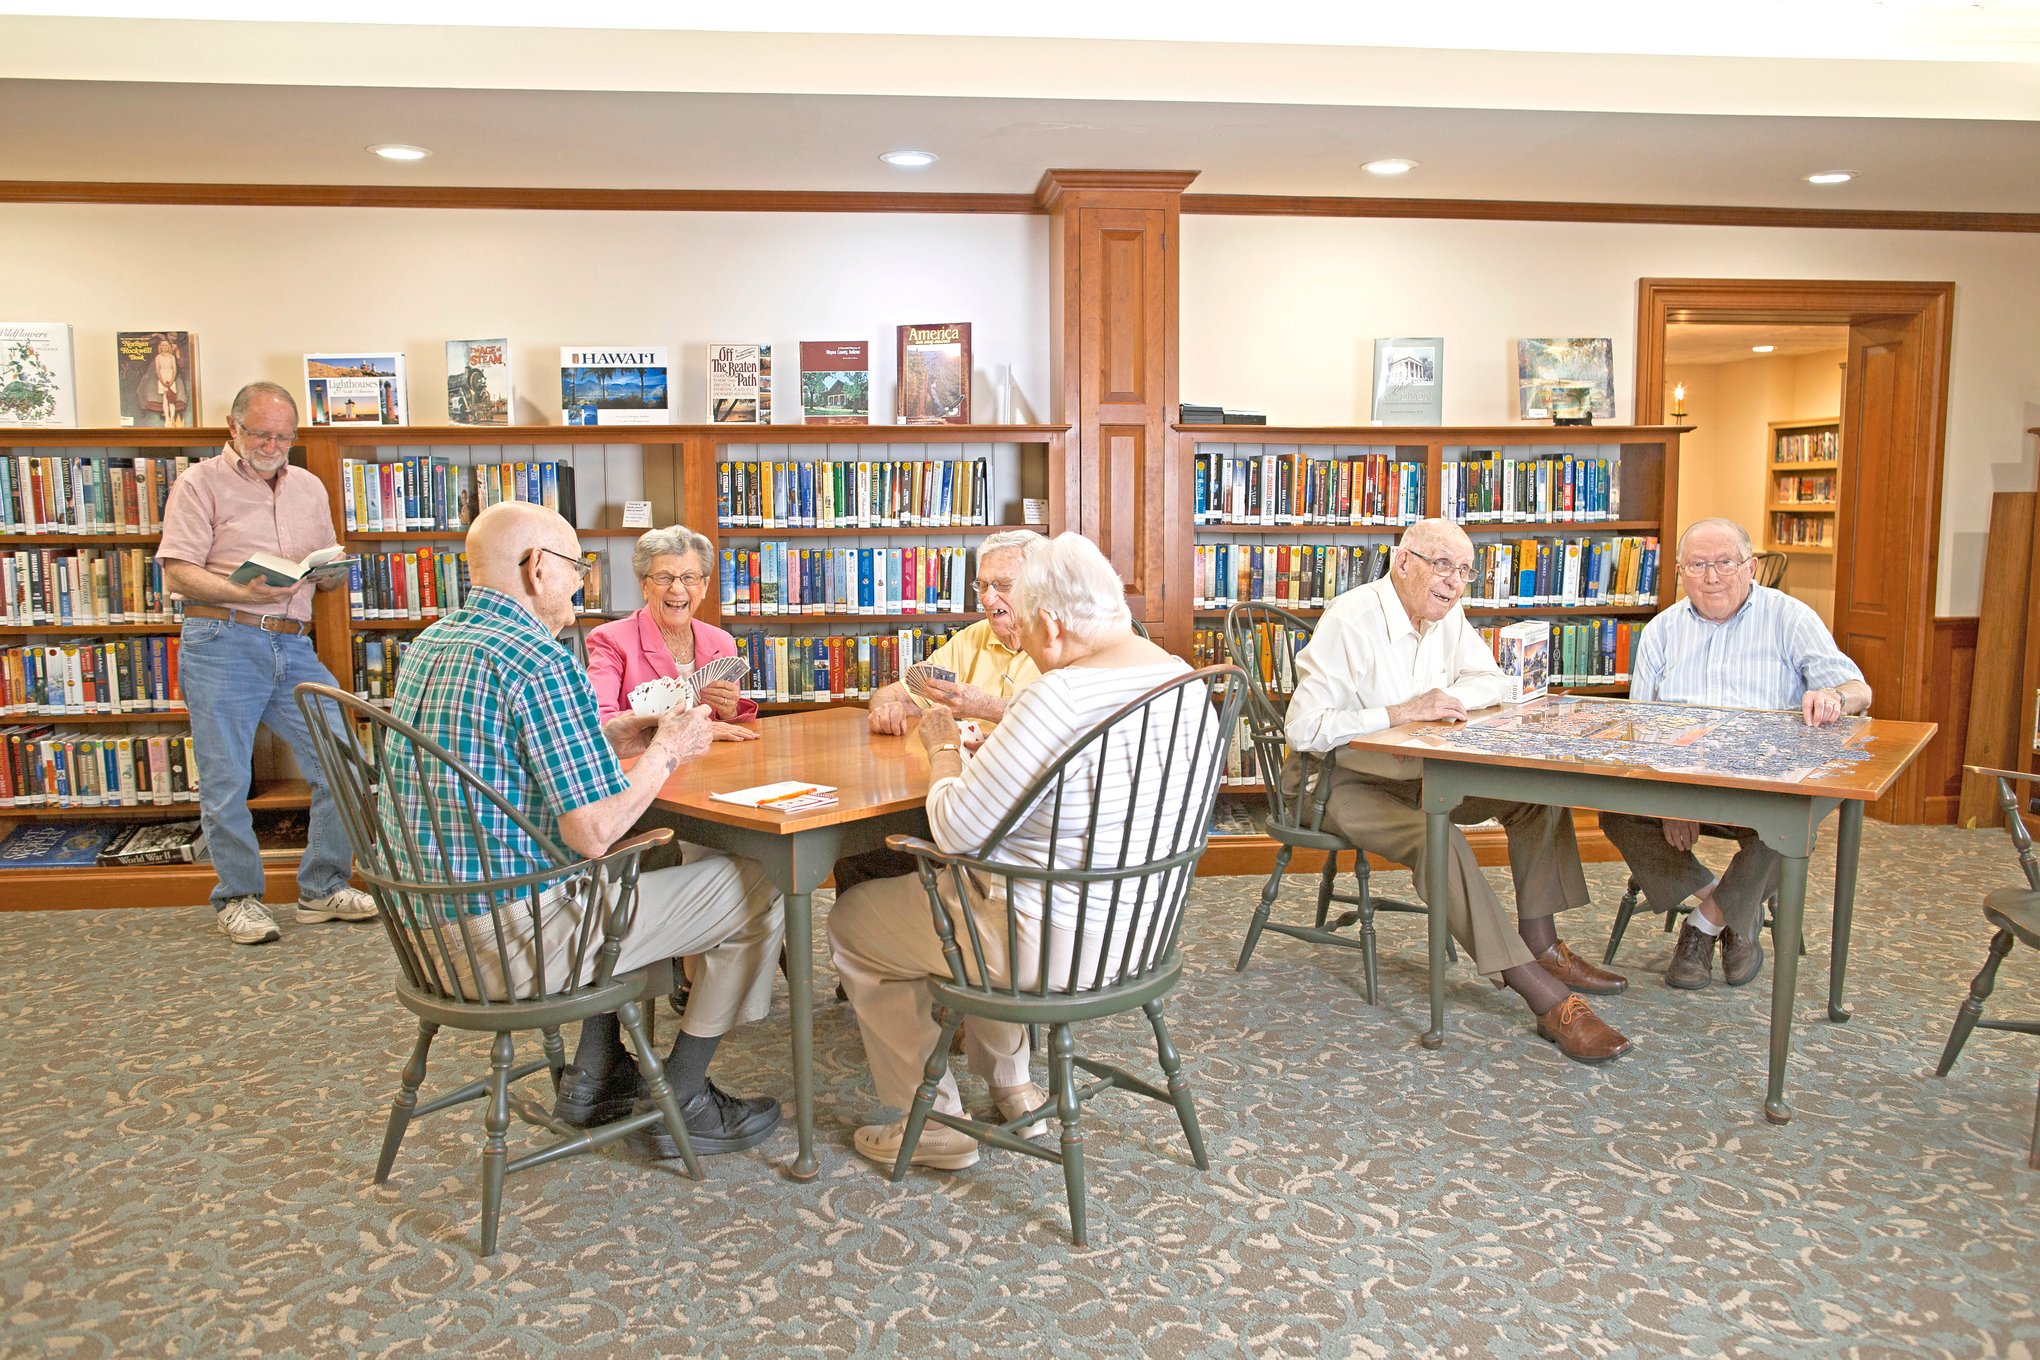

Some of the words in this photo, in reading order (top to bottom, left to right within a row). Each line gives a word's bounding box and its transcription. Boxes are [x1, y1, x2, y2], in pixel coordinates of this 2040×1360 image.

[908, 326, 959, 343] America
[120, 347, 152, 355] Rockwell
[122, 340, 149, 348] Norman
[479, 345, 496, 355] AGE
[470, 354, 502, 366] STEAM
[719, 347, 734, 361] Off
[711, 358, 726, 373] The
[725, 361, 757, 378] Beaten
[328, 379, 378, 391] Lighthouses
[735, 373, 757, 387] Path
[62, 459, 70, 483] DANIELLE
[31, 553, 39, 582] INDIANAPOLIS
[42, 552, 50, 578] COUNTDOWN
[351, 571, 359, 590] CARTER
[82, 573, 90, 605] Educated
[134, 646, 142, 662] DAVID
[152, 640, 161, 656] DAVID
[136, 662, 144, 685] BALDACCI
[154, 657, 162, 683] BALDACCI
[119, 855, 145, 864] World
[146, 853, 163, 861] War
